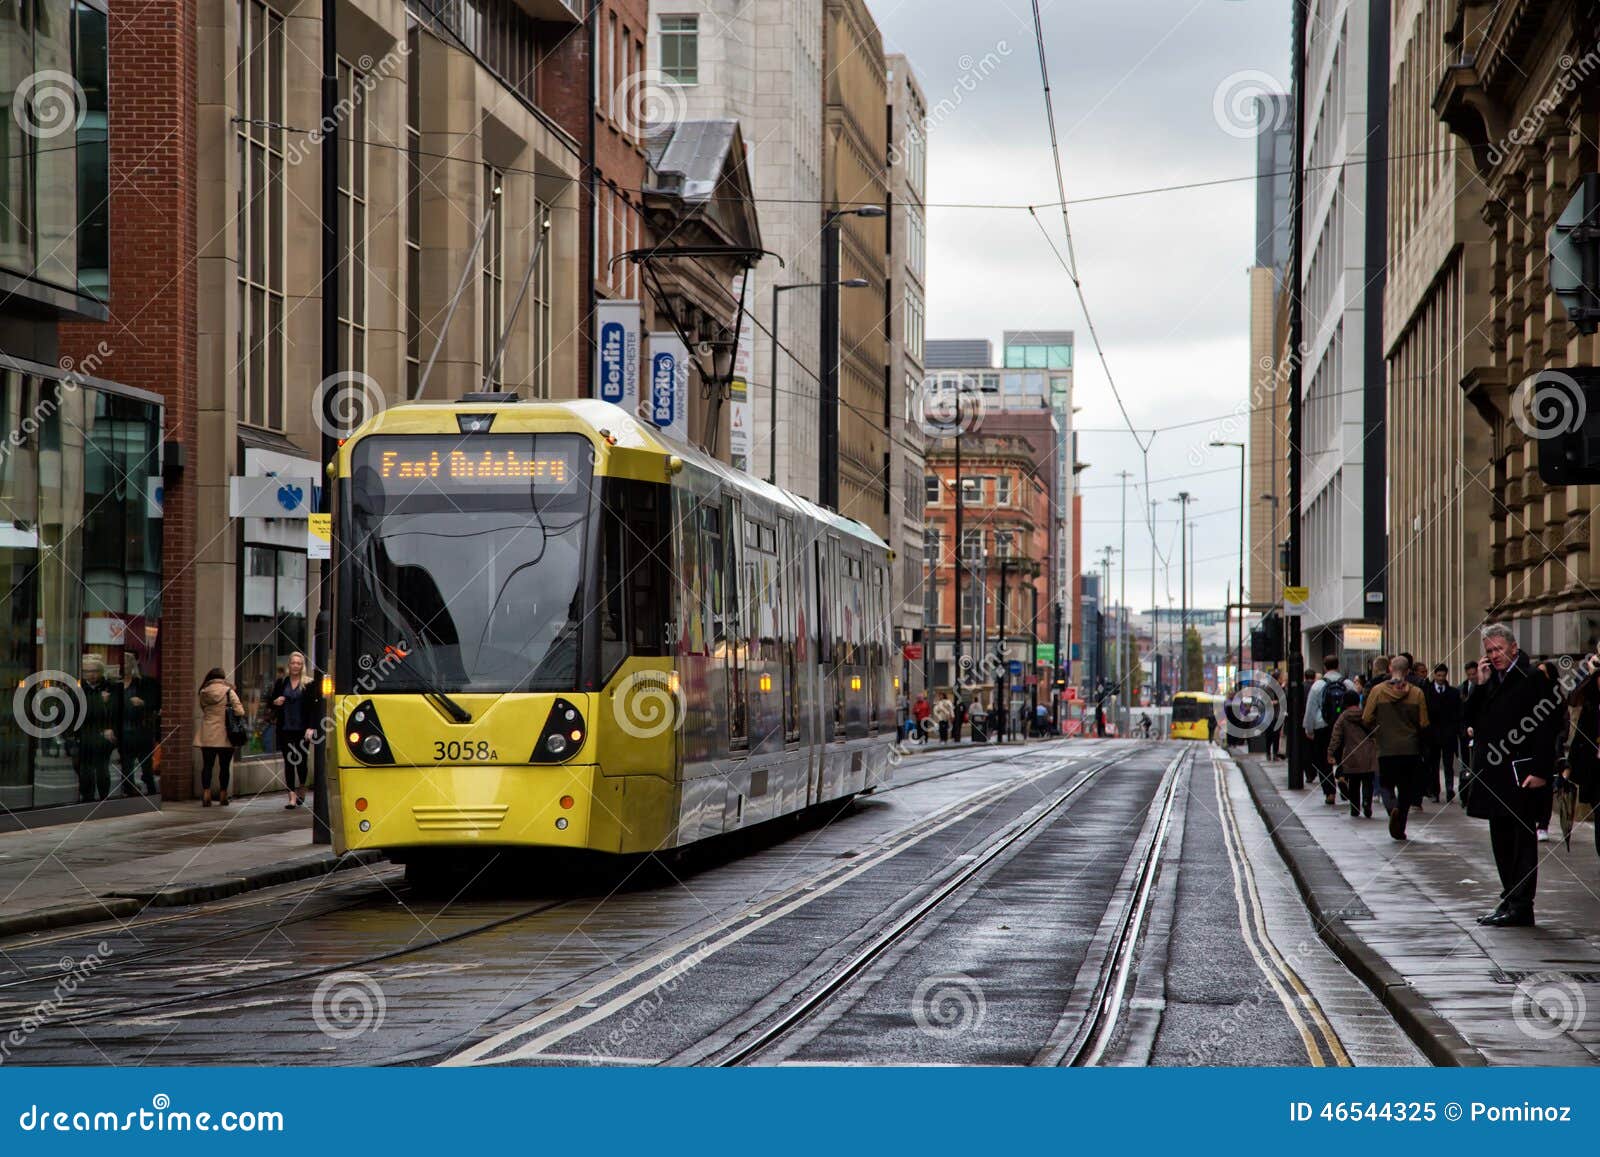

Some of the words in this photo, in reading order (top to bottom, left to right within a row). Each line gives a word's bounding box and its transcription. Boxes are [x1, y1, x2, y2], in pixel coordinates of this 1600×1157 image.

[603, 330, 620, 396] Berlitz
[626, 332, 636, 396] MANCHESTER
[433, 741, 498, 761] 3058A
